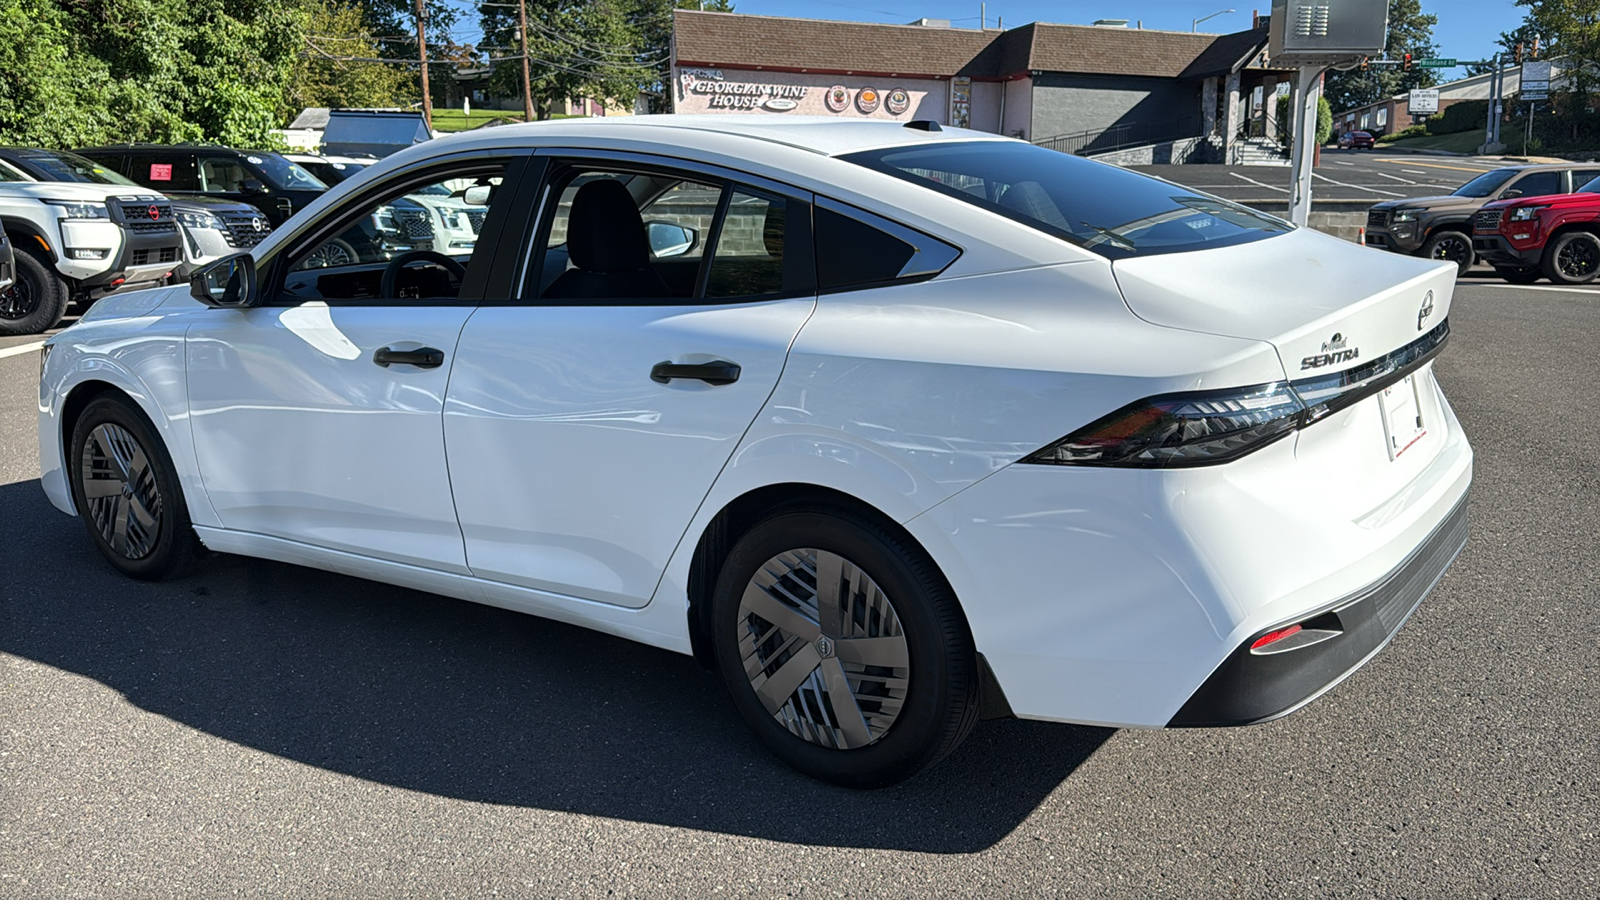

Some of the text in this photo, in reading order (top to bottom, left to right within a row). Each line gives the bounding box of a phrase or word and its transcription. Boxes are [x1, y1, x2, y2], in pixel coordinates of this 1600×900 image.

[695, 82, 808, 98] GEORGIAN WINE
[712, 95, 758, 108] HOUSE
[1300, 347, 1359, 371] SENTRA
